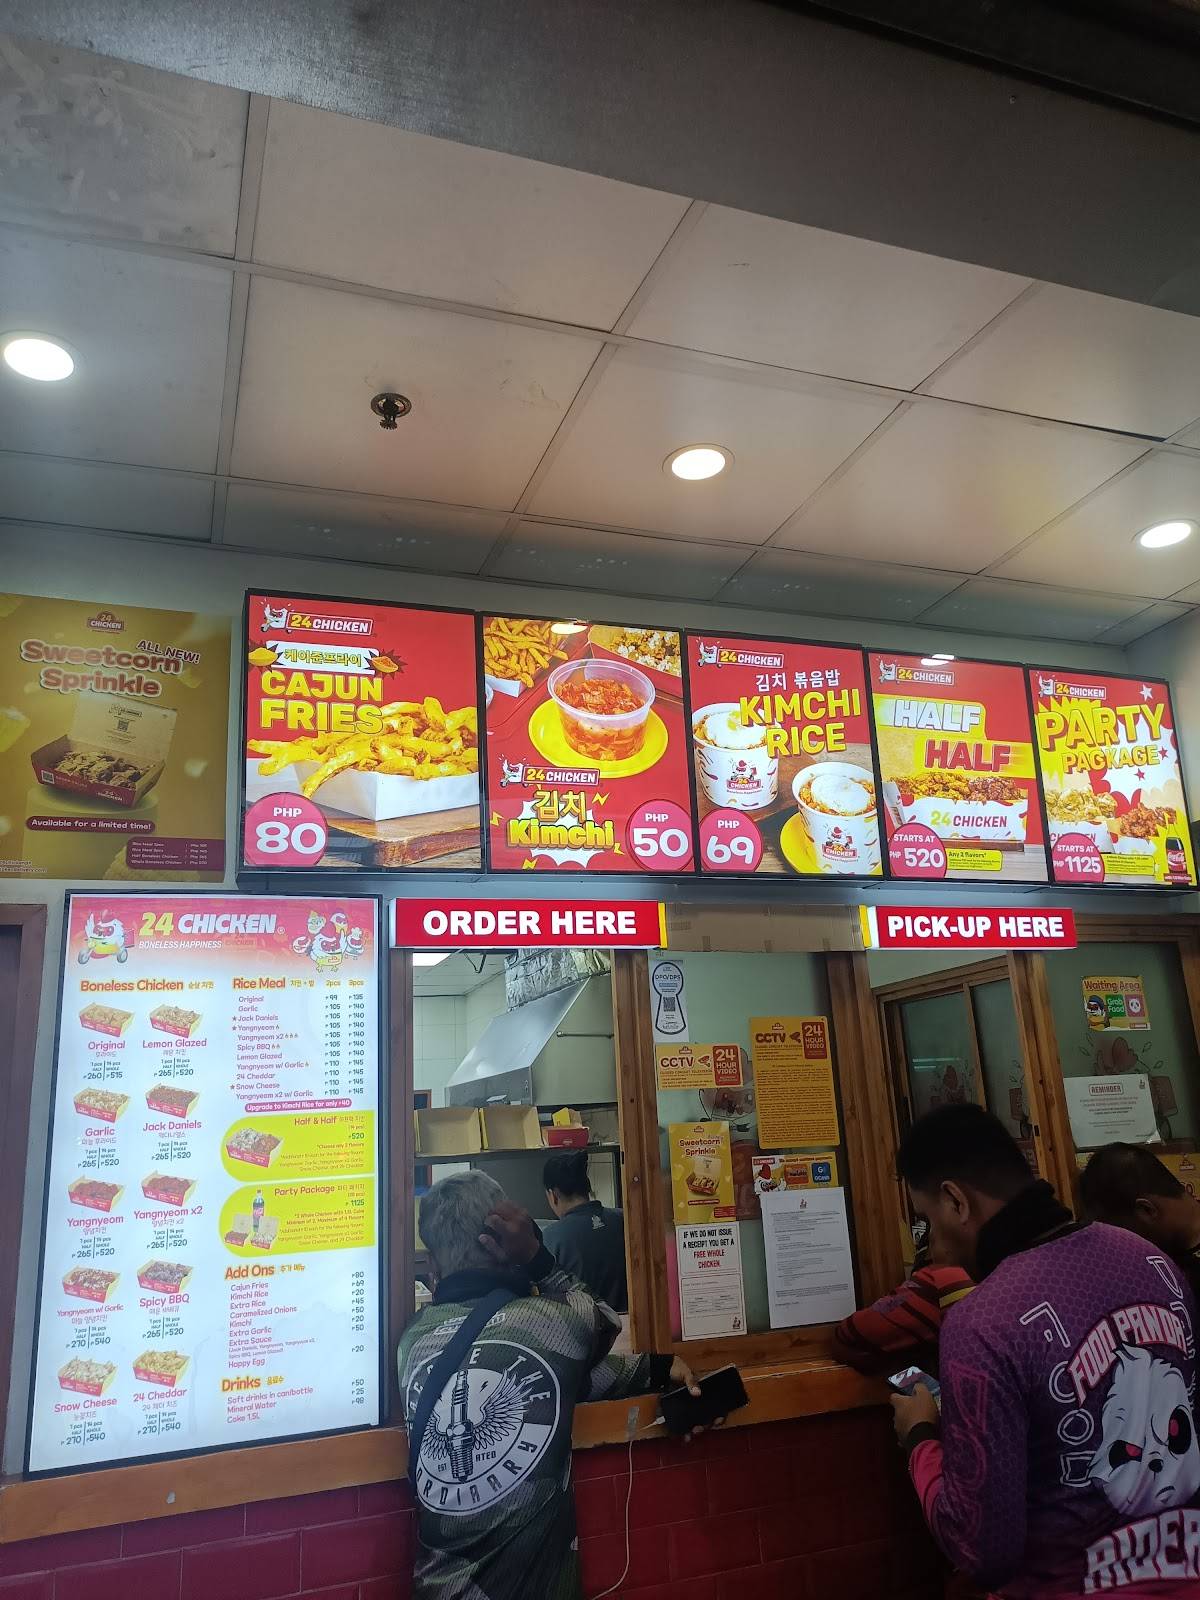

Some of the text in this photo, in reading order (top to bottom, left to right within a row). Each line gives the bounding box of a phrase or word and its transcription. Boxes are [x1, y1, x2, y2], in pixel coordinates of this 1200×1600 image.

[90, 621, 122, 629] CHICKEN
[291, 615, 368, 632] 24 CHICKEN
[22, 639, 182, 674] Sweetcorn
[138, 640, 200, 664] ALL NEW!
[284, 649, 362, 667] 케이준프라이
[720, 652, 781, 666] 24 CHICKEN
[41, 668, 161, 697] Sprinkle
[756, 669, 840, 692] 김치 볶음밥
[898, 669, 951, 683] 24 CHICKEN
[261, 671, 383, 702] CAJUN
[1057, 684, 1104, 697] 24 CHICKEN
[740, 688, 861, 726] KIMCHI
[261, 698, 384, 734] FRIES
[894, 699, 981, 732] HALF
[1038, 703, 1164, 751] PARTY
[766, 722, 847, 758] RICE
[925, 739, 1011, 772] HALF
[1062, 744, 1160, 774] PACKAGE
[527, 769, 595, 783] 24 CHICKEN
[274, 807, 302, 817] PHP
[535, 790, 587, 821] 김치
[645, 813, 669, 821] PHP
[930, 811, 1007, 827] 24 CHICKEN
[31, 819, 72, 828] Available
[98, 821, 128, 829] limited
[130, 822, 151, 830] time!
[717, 820, 740, 828] PHP
[256, 821, 325, 854] 80
[508, 818, 614, 849] Kimchi
[894, 834, 923, 843] STARTS
[633, 828, 688, 857] 50
[706, 836, 754, 864] 69
[889, 850, 901, 859] PHP
[904, 848, 944, 868] 520
[1065, 856, 1101, 873] 1125
[138, 912, 277, 936] 24 CHICKEN
[423, 910, 636, 936] ORDER HERE
[887, 916, 1064, 938] PICK-UP HERE
[139, 941, 222, 949] BONELESS HAPPINESS
[80, 979, 183, 992] Boneless Chicken
[233, 977, 285, 989] Rice Meal
[1084, 981, 1140, 993] Waiting Area
[1107, 997, 1123, 1007] Grab
[1108, 1005, 1124, 1013] Food
[804, 1025, 823, 1036] 24
[143, 1038, 207, 1048] Lemon Glazed
[755, 1033, 786, 1043] CCTV
[88, 1040, 125, 1050] Original
[715, 1049, 735, 1061] 24
[660, 1056, 694, 1068] CCTV
[1091, 1085, 1122, 1093] REMINDER
[247, 1103, 272, 1111] Upgrade
[143, 1120, 202, 1131] Jack Daniels
[294, 1118, 313, 1126] Half
[320, 1116, 337, 1124] Half
[85, 1127, 115, 1137] Garlic
[275, 1188, 298, 1196] Party
[301, 1186, 335, 1194] Package
[134, 1206, 203, 1220] Yangnyeom x2
[67, 1216, 124, 1228] Yangnyeom
[688, 1240, 707, 1248] RECEIPT
[707, 1249, 725, 1257] WHOLE
[225, 1265, 275, 1280] Add Ons
[231, 1284, 250, 1292] Cajun
[140, 1294, 190, 1308] Spicy BBQ
[105, 1304, 124, 1312] Garlic
[230, 1308, 272, 1319] Caramelized
[230, 1320, 251, 1328] Kimchi
[229, 1338, 249, 1347] Extra
[1068, 1306, 1189, 1404] FOOD PANDA
[228, 1358, 265, 1368] Happy Egg
[222, 1376, 261, 1392] Drinks
[508, 1355, 551, 1402] THE
[133, 1388, 187, 1402] 24 Cheddar
[228, 1395, 243, 1404] Soft
[246, 1393, 267, 1402] drinks
[54, 1399, 118, 1413] Snow Cheese
[227, 1401, 277, 1413] Mineral Water
[227, 1415, 245, 1423] Coke
